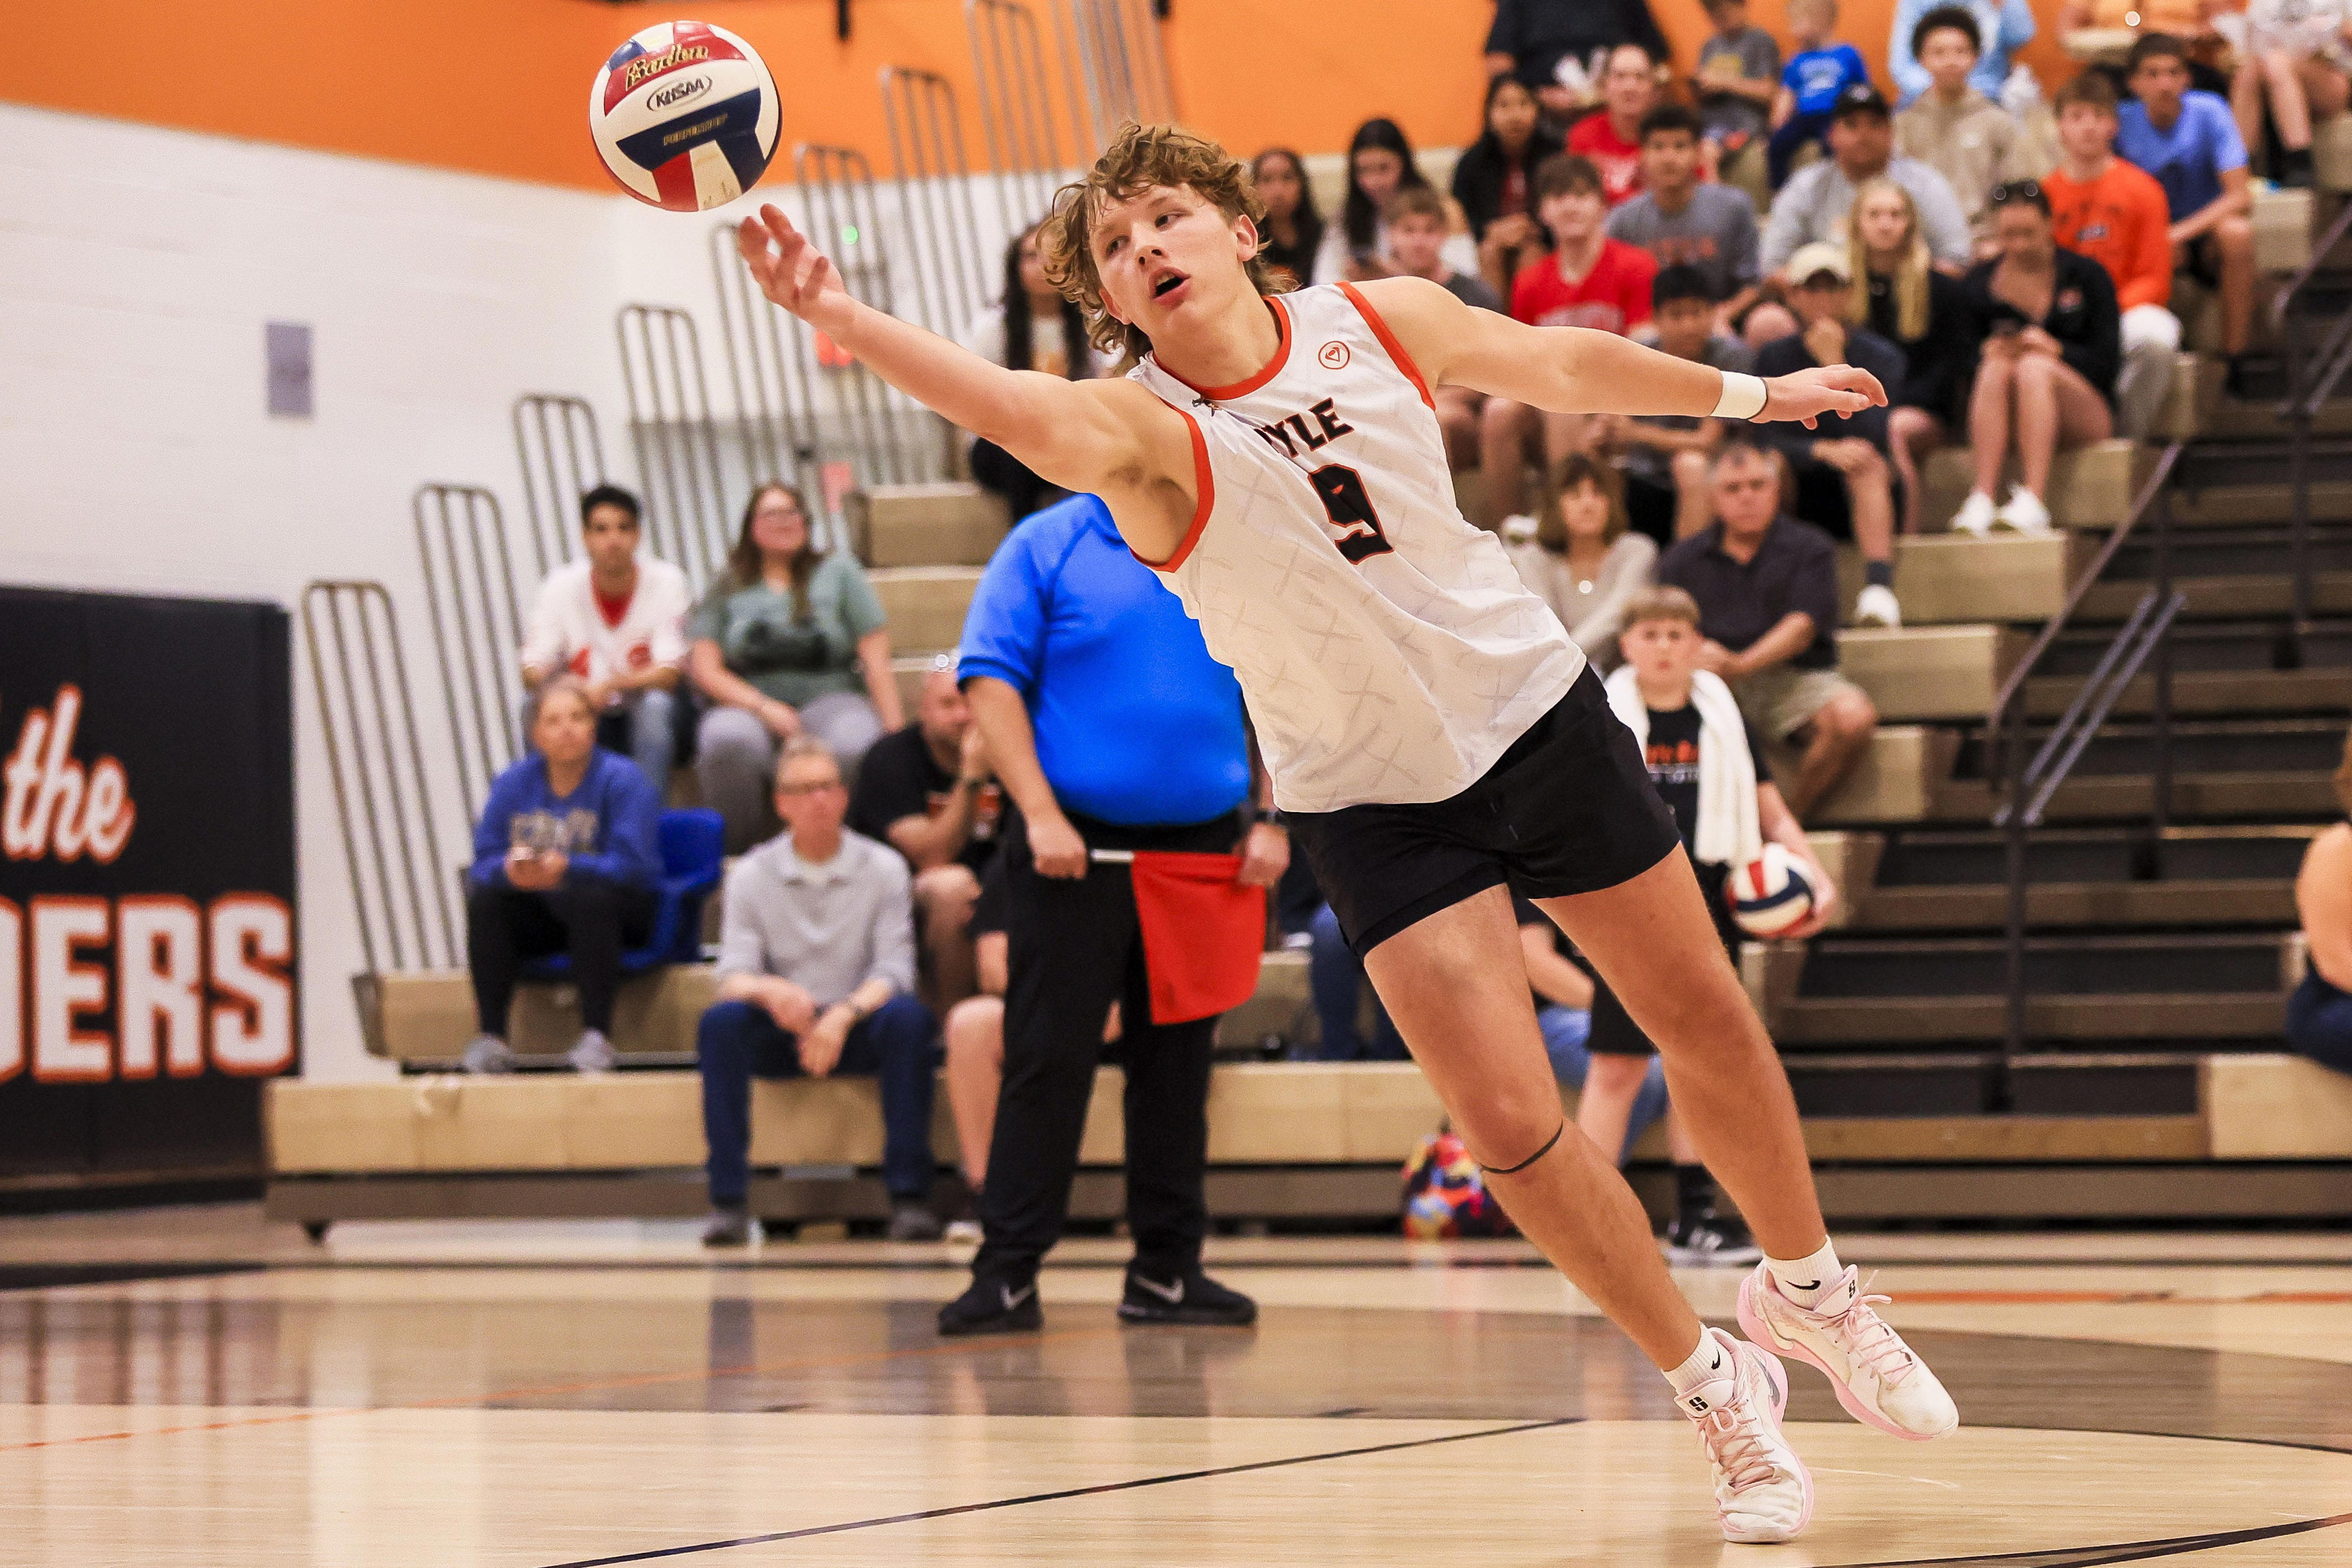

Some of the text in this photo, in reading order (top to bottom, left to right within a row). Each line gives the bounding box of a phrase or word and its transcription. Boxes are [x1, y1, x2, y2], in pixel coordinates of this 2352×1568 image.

[625, 42, 709, 92] Baden
[656, 78, 704, 108] KHSAA
[1307, 463, 1394, 565] 9
[1, 682, 136, 864] the
